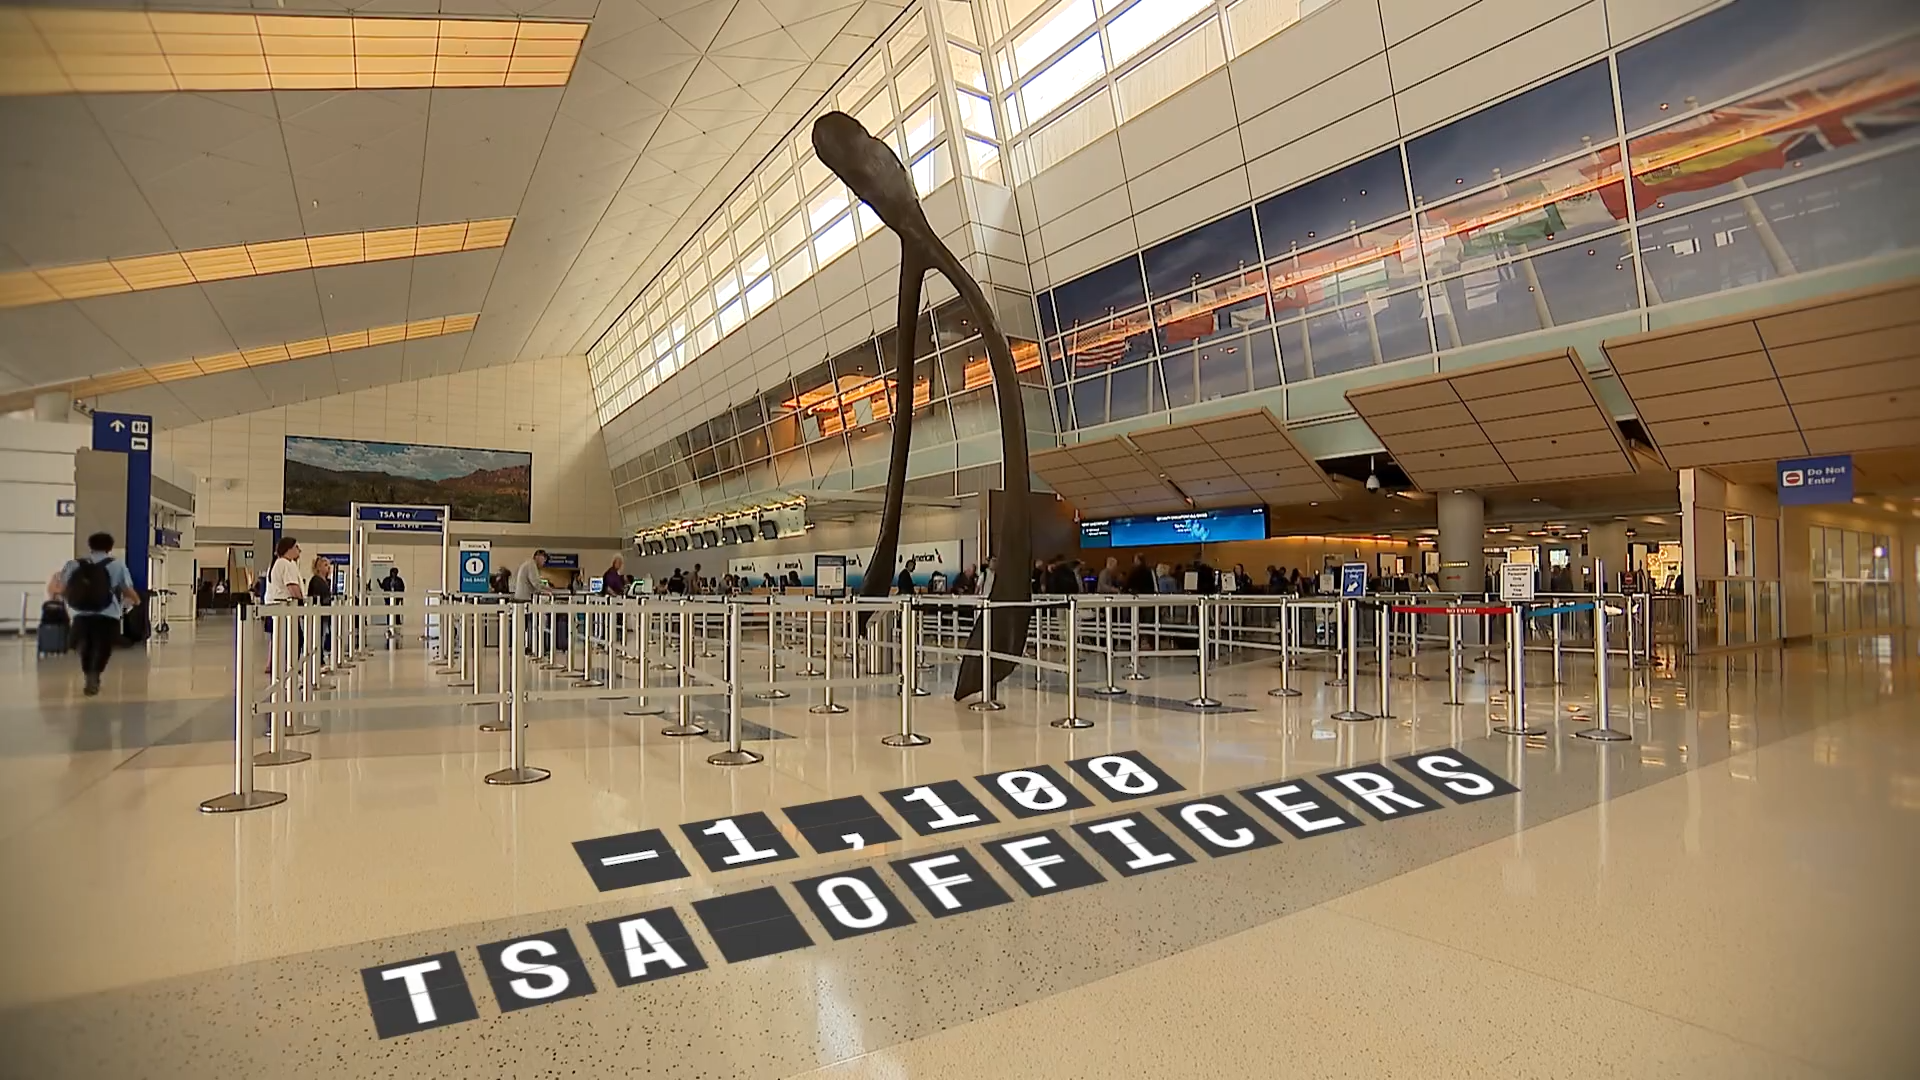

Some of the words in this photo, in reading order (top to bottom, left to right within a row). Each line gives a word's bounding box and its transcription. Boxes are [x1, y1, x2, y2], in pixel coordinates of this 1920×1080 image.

[1807, 468, 1823, 476] Do
[1825, 466, 1846, 475] Not
[1807, 477, 1836, 485] Enter
[379, 511, 395, 519] TSA
[472, 560, 477, 572] 1
